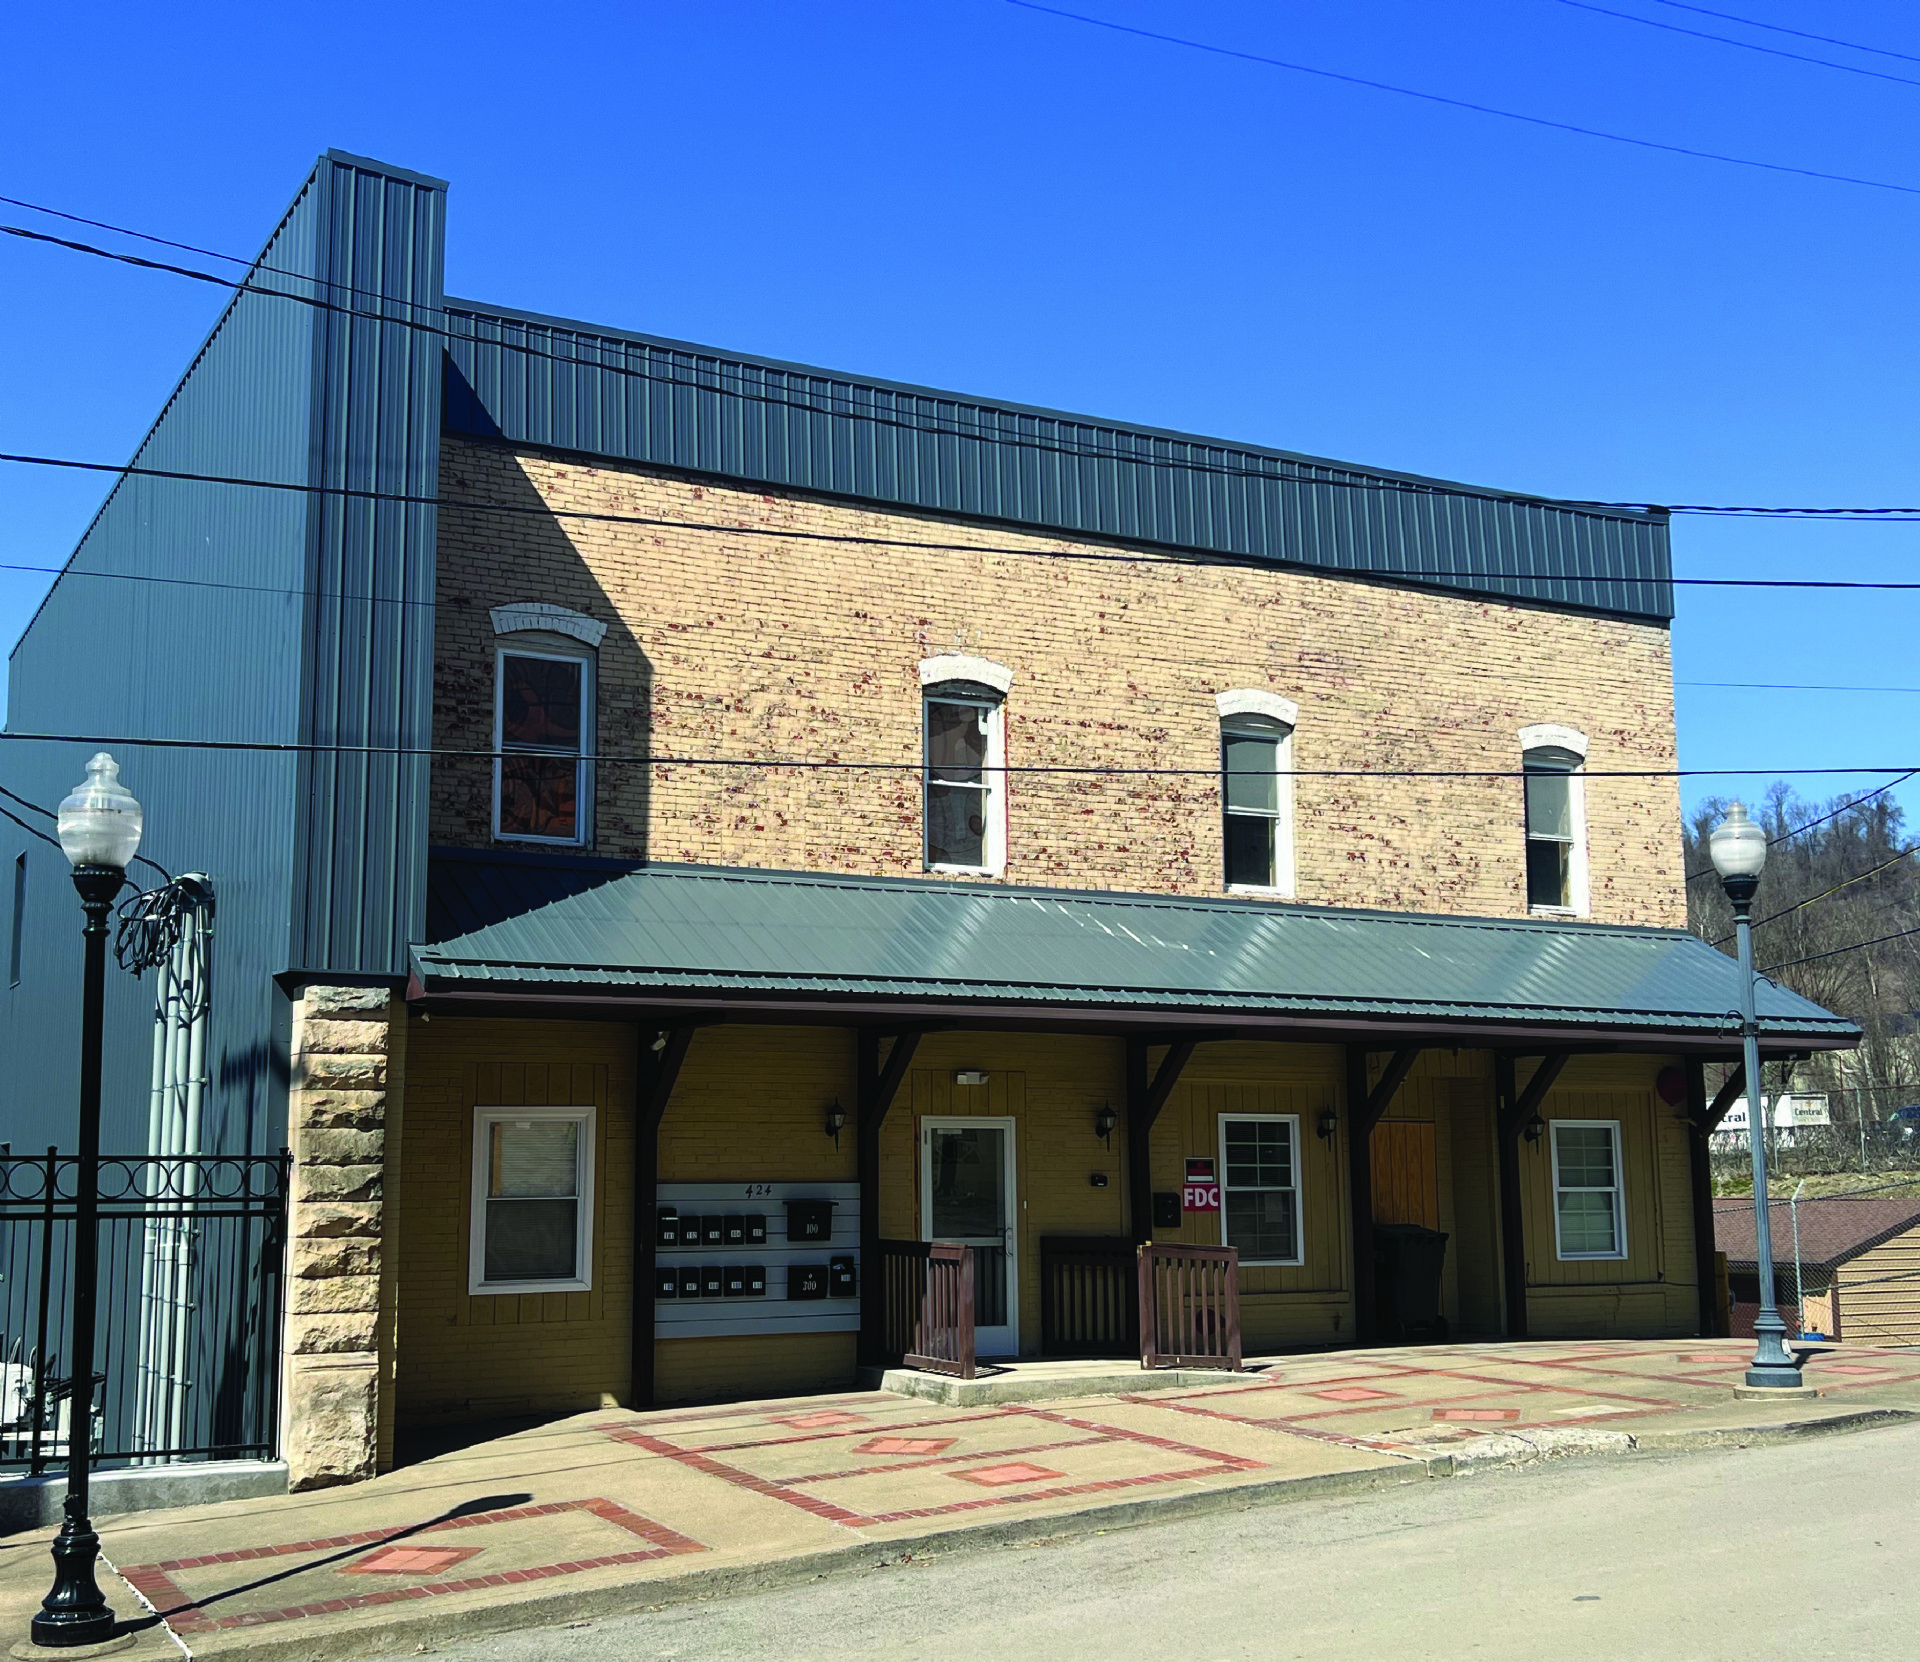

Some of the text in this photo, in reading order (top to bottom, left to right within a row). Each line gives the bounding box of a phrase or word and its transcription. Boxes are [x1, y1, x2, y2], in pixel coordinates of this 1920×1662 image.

[1794, 1107, 1823, 1116] Central
[745, 1184, 772, 1199] 424
[1184, 1187, 1219, 1207] FDC
[806, 1223, 819, 1235] 100
[802, 1281, 817, 1291] 300
